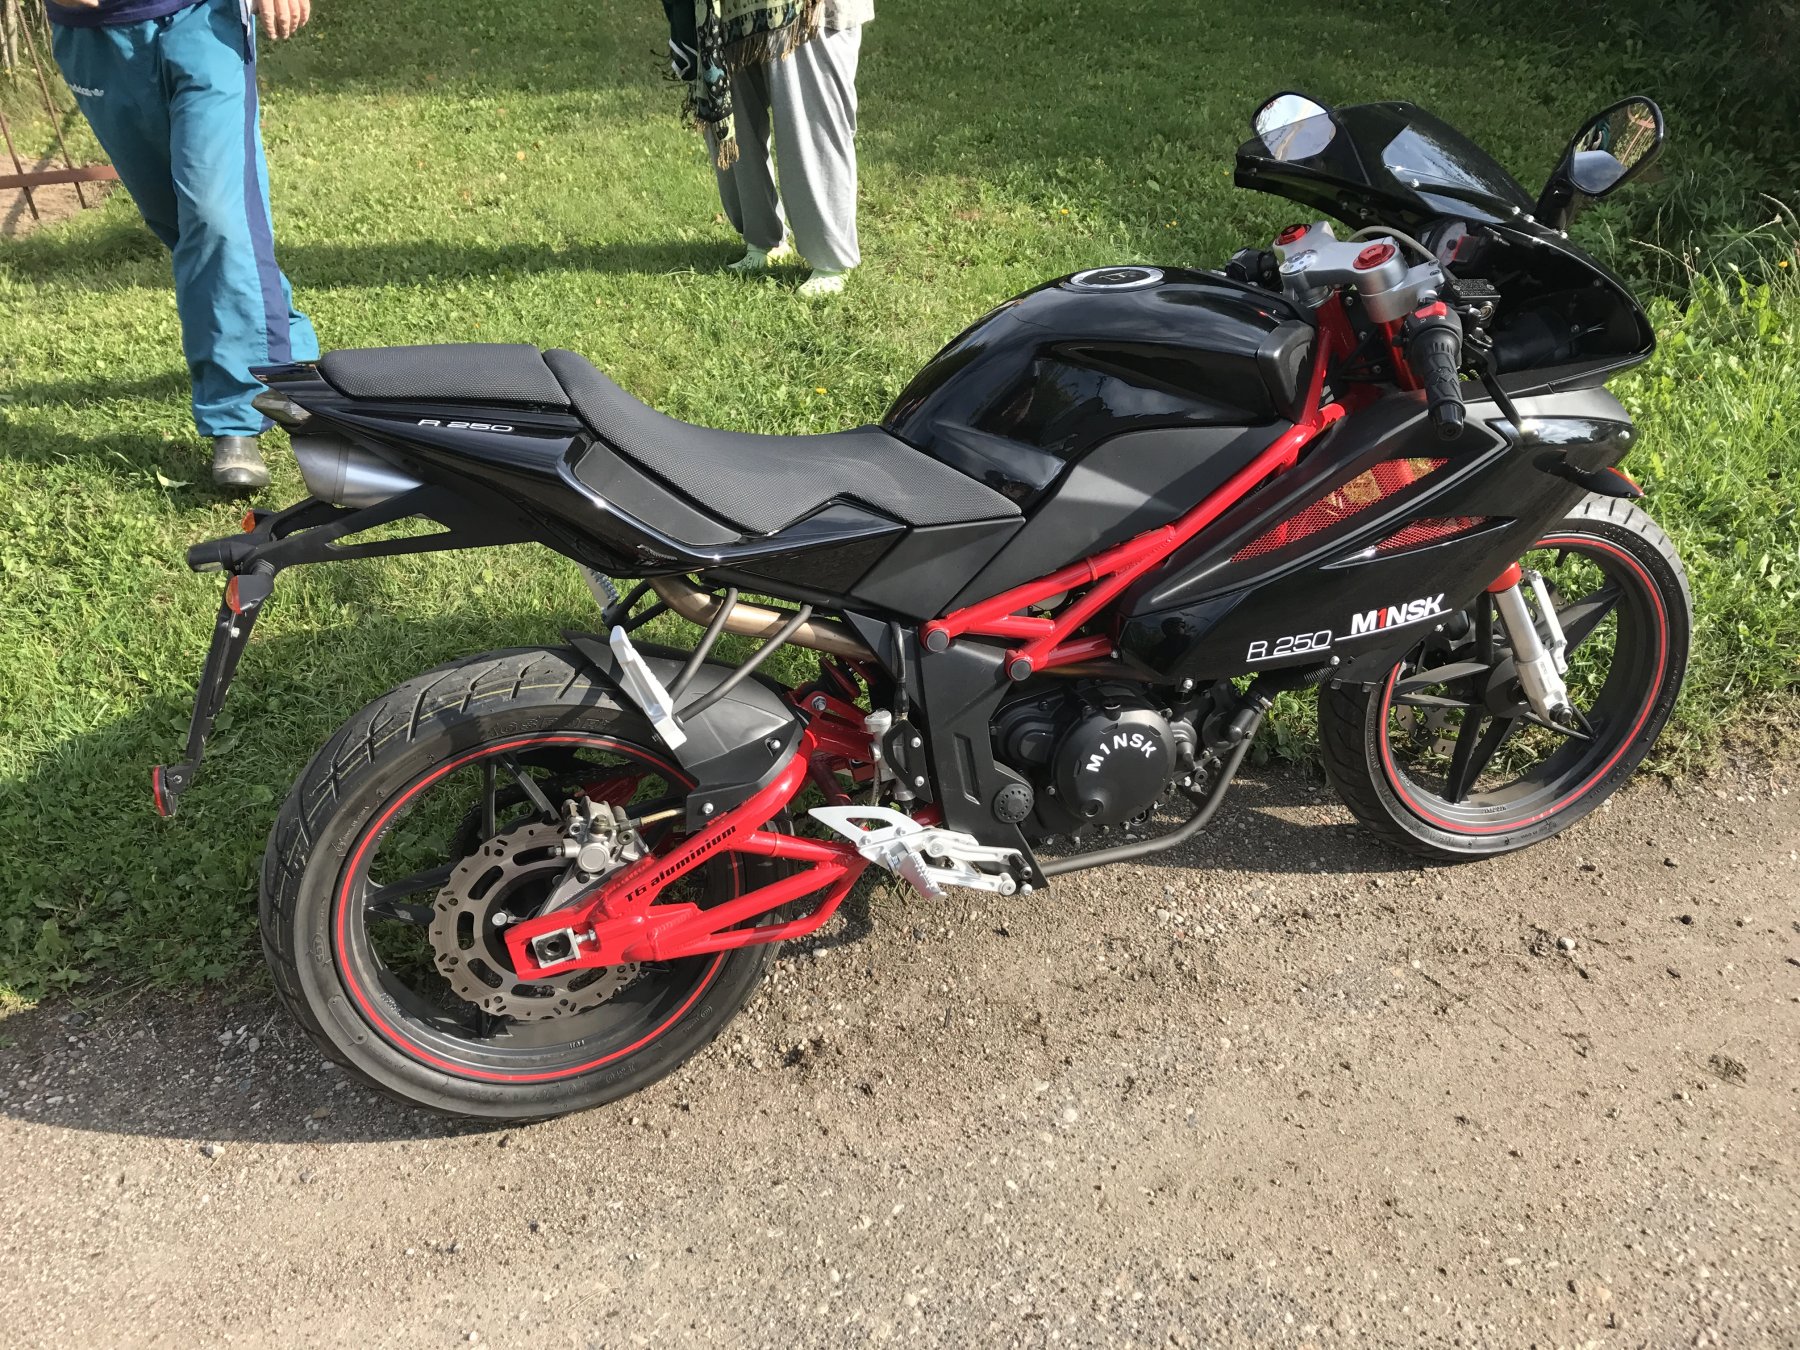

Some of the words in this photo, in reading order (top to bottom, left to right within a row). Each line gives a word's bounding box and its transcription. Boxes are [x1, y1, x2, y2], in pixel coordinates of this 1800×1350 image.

[417, 419, 441, 427] R
[446, 421, 514, 432] 250
[1247, 640, 1268, 661] R
[1273, 629, 1332, 655] 250
[624, 885, 648, 902] T6
[650, 825, 737, 887] aluminium
